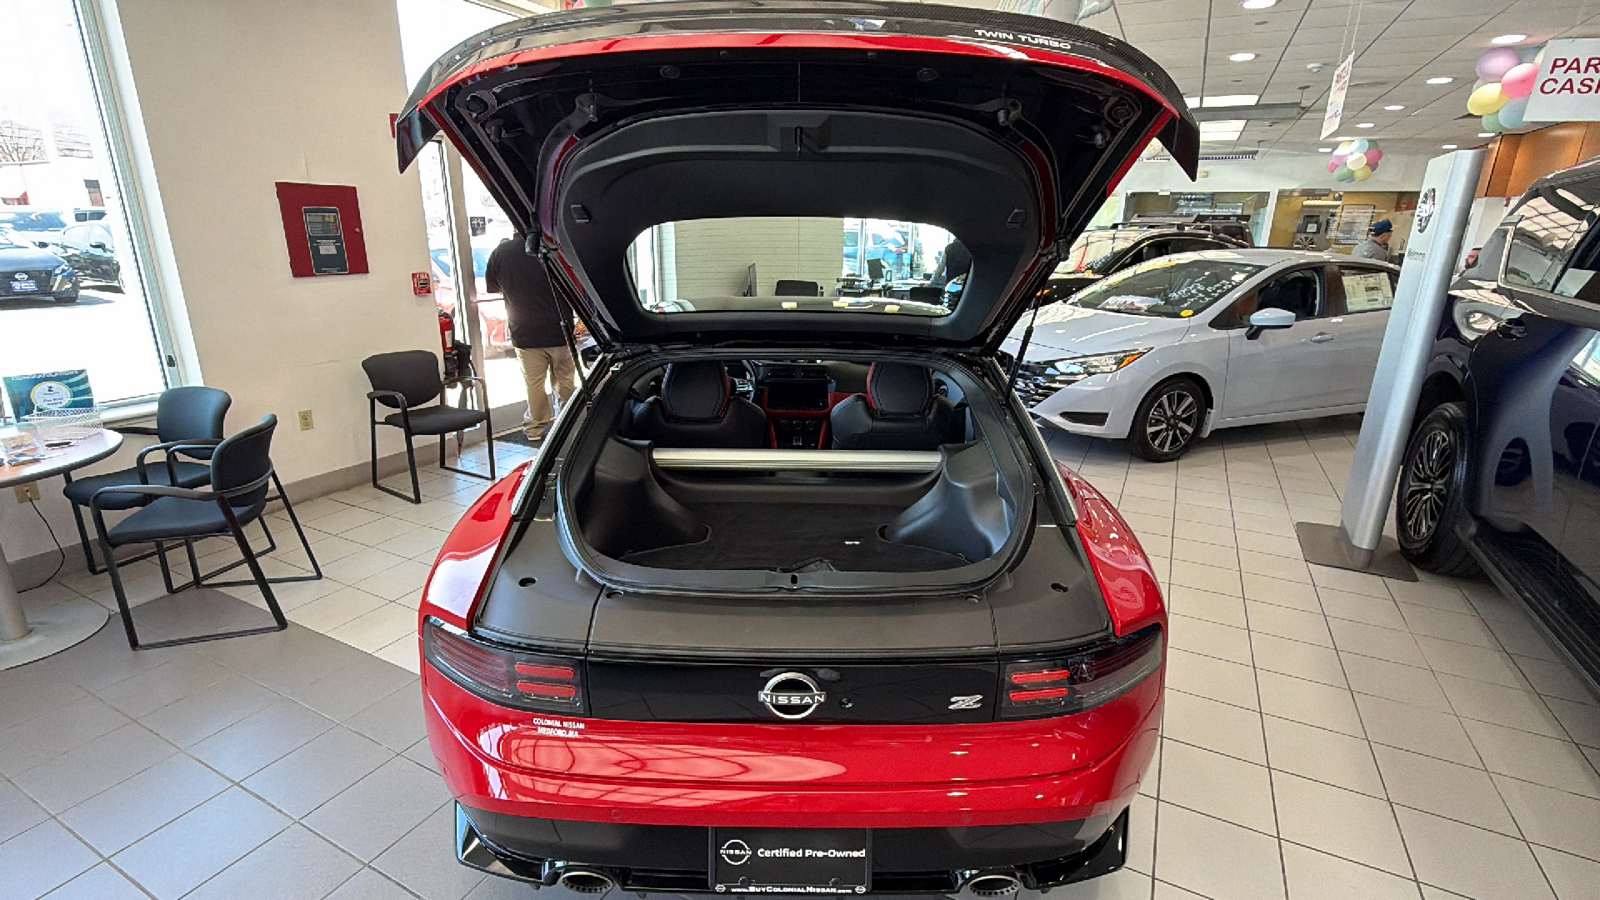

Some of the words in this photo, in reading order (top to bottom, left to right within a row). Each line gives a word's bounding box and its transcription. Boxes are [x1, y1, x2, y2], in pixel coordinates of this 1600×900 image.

[974, 29, 1014, 40] TWIN
[1017, 34, 1072, 50] TURBO
[760, 693, 825, 704] NISSAN
[532, 717, 562, 728] COLONIAL
[562, 721, 585, 729] NISSAN
[719, 848, 752, 856] NISSAN
[757, 847, 803, 858] Certified
[804, 848, 866, 858] Pre-Owned
